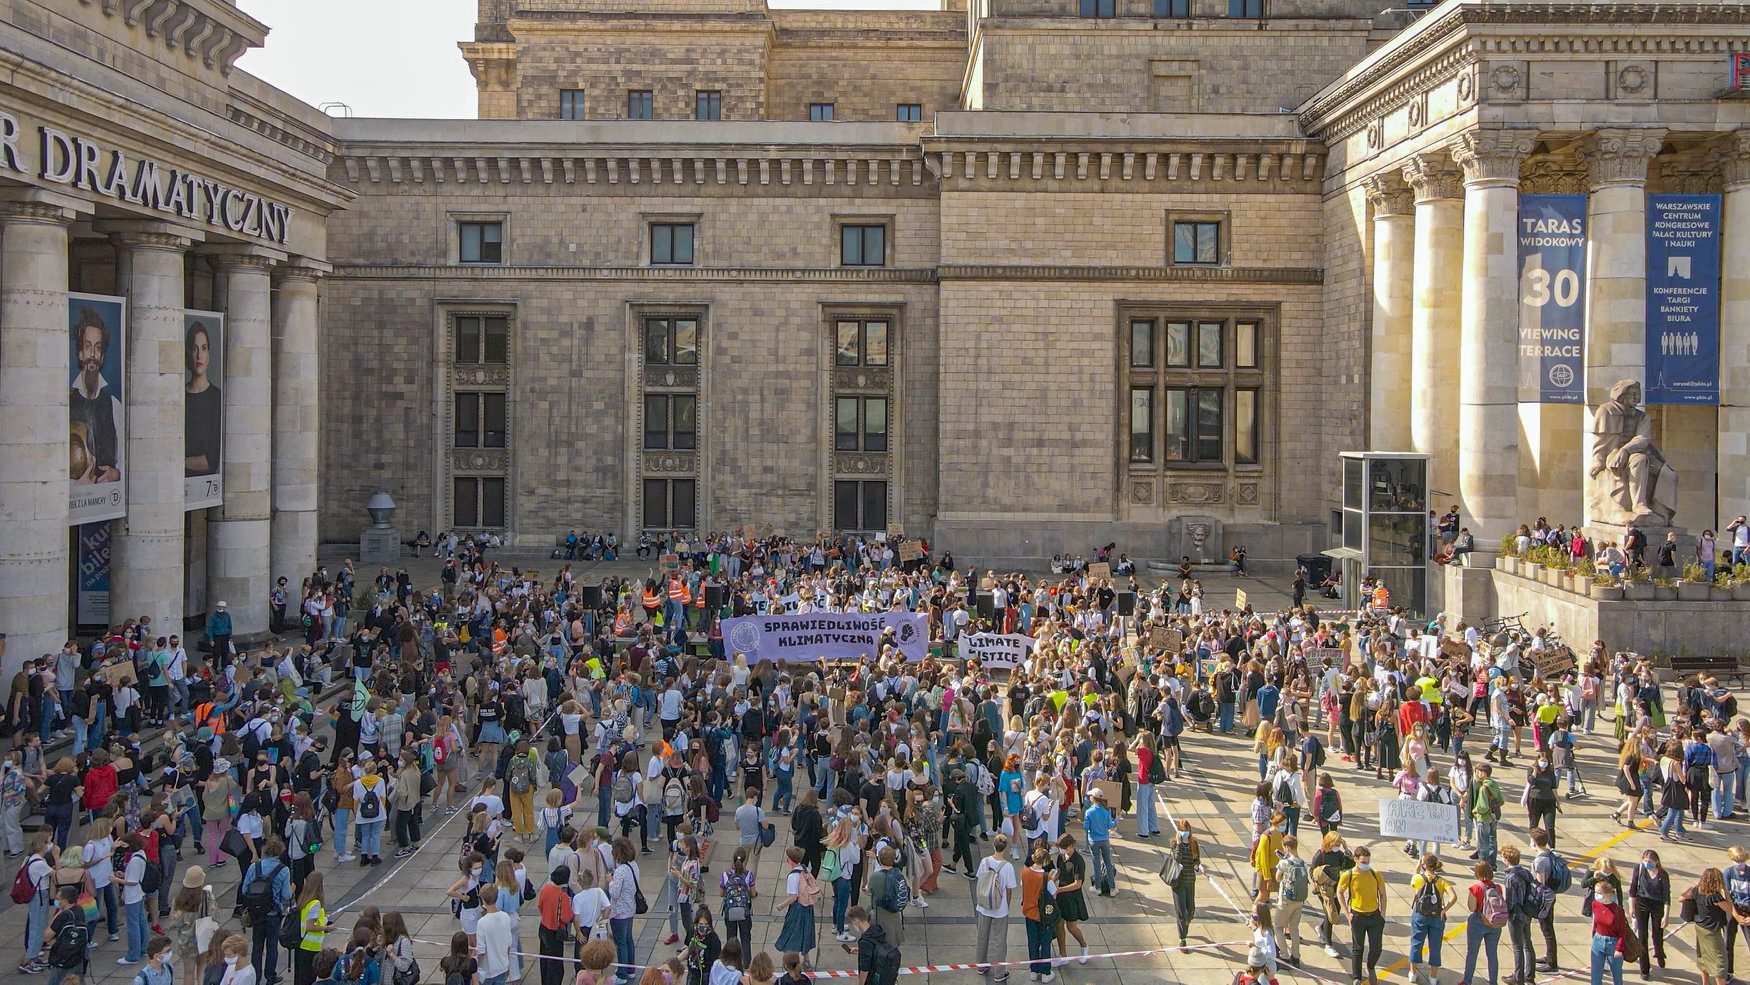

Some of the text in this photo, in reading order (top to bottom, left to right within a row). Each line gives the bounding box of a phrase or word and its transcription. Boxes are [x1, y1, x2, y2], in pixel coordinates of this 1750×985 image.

[38, 126, 296, 244] DRAMATYCZNY
[1522, 218, 1582, 234] TARAS
[1655, 221, 1710, 229] KONGRESOWE
[1520, 237, 1585, 247] WIDOKOWY
[1523, 269, 1579, 307] 30
[1653, 287, 1708, 295] KONFERENCJE
[1518, 328, 1580, 341] VIEWING
[1519, 345, 1581, 357] TERRACE
[206, 480, 212, 497] 7
[87, 497, 106, 506] MANCHY
[764, 617, 886, 633] SPRAWIEDLIWOŚĆ
[778, 633, 874, 647] KLIMATYCZNA
[1388, 800, 1425, 820] ARE
